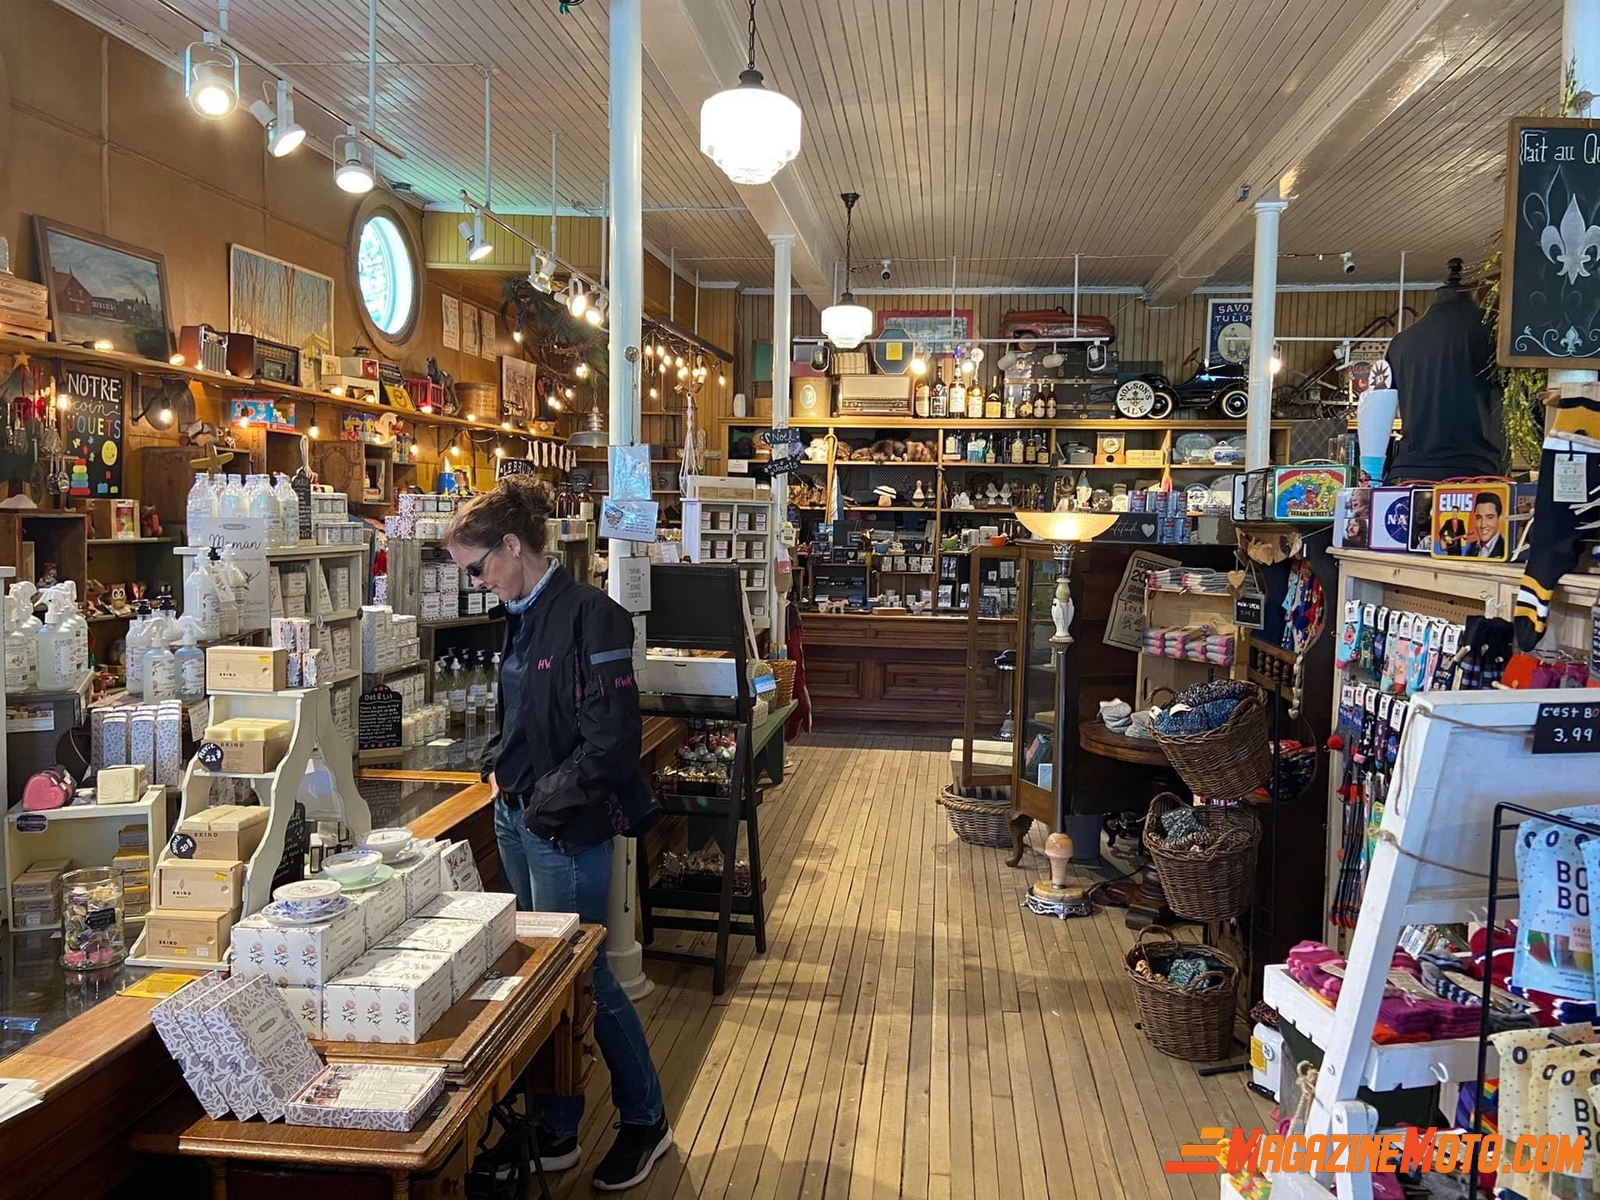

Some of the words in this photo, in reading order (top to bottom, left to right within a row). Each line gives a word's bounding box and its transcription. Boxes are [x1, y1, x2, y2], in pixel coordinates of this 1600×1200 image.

[1524, 133, 1549, 163] Fait
[1553, 145, 1576, 161] au
[1218, 304, 1252, 314] SAVO
[68, 373, 120, 403] NOTRE
[73, 400, 121, 416] coin
[1123, 405, 1147, 415] ALE
[66, 415, 122, 439] JOUETS
[1439, 493, 1473, 512] ELVIS
[1553, 726, 1593, 743] 3,99
